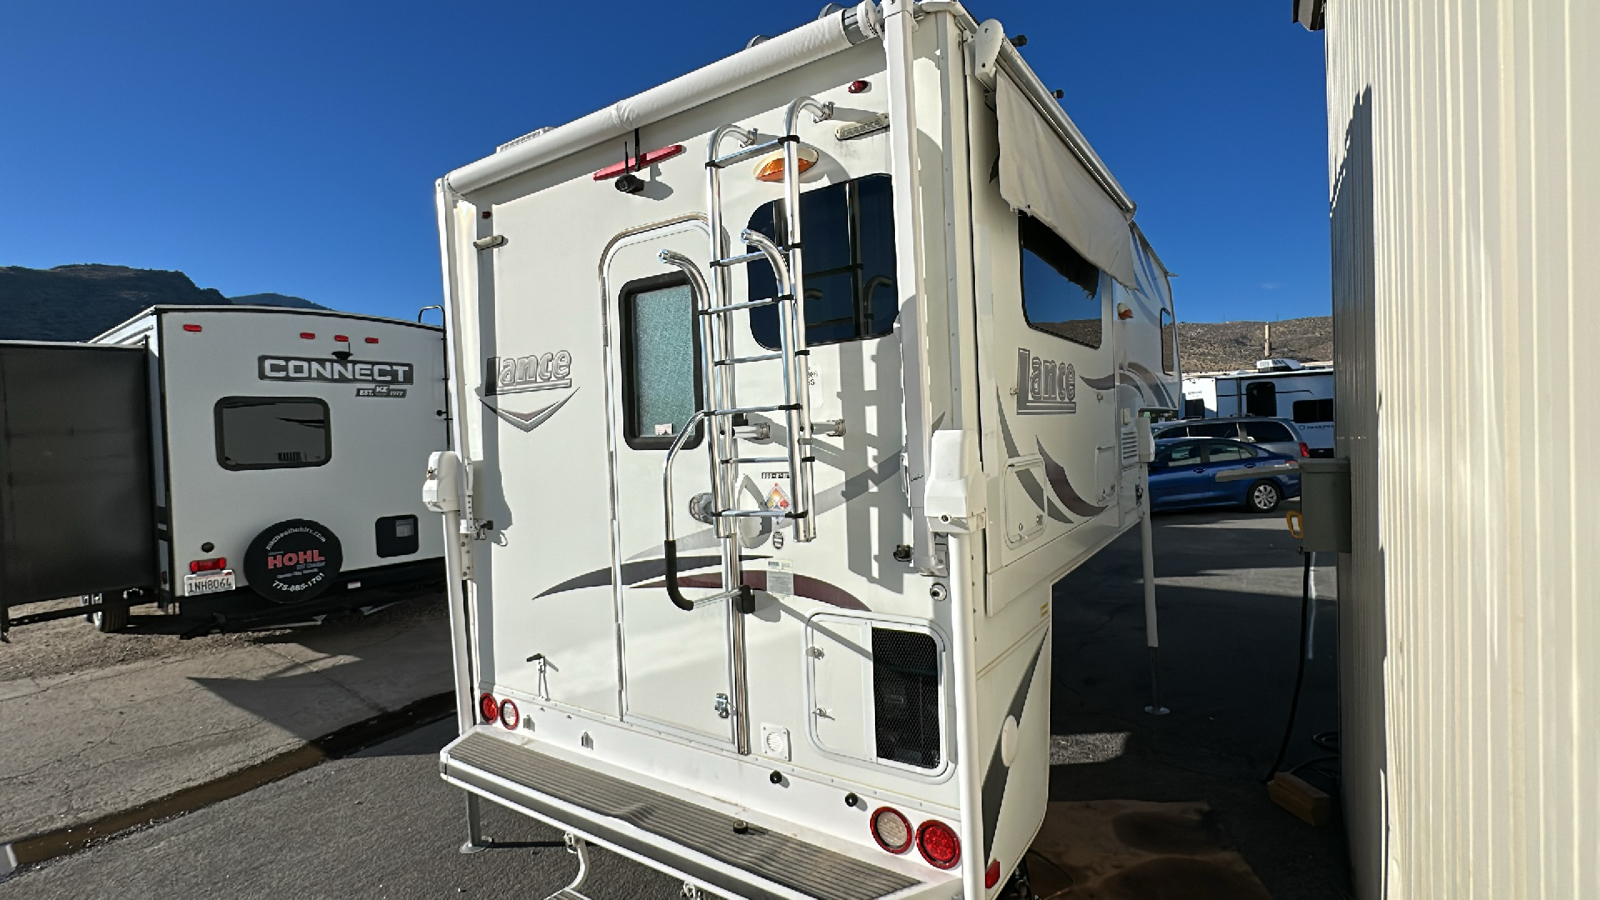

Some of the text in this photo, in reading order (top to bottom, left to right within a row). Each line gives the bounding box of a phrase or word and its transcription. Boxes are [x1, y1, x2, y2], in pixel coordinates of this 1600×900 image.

[264, 359, 409, 382] CONNECT
[485, 350, 572, 396] Lance
[1017, 347, 1076, 415] Lance
[268, 549, 325, 569] HOHL
